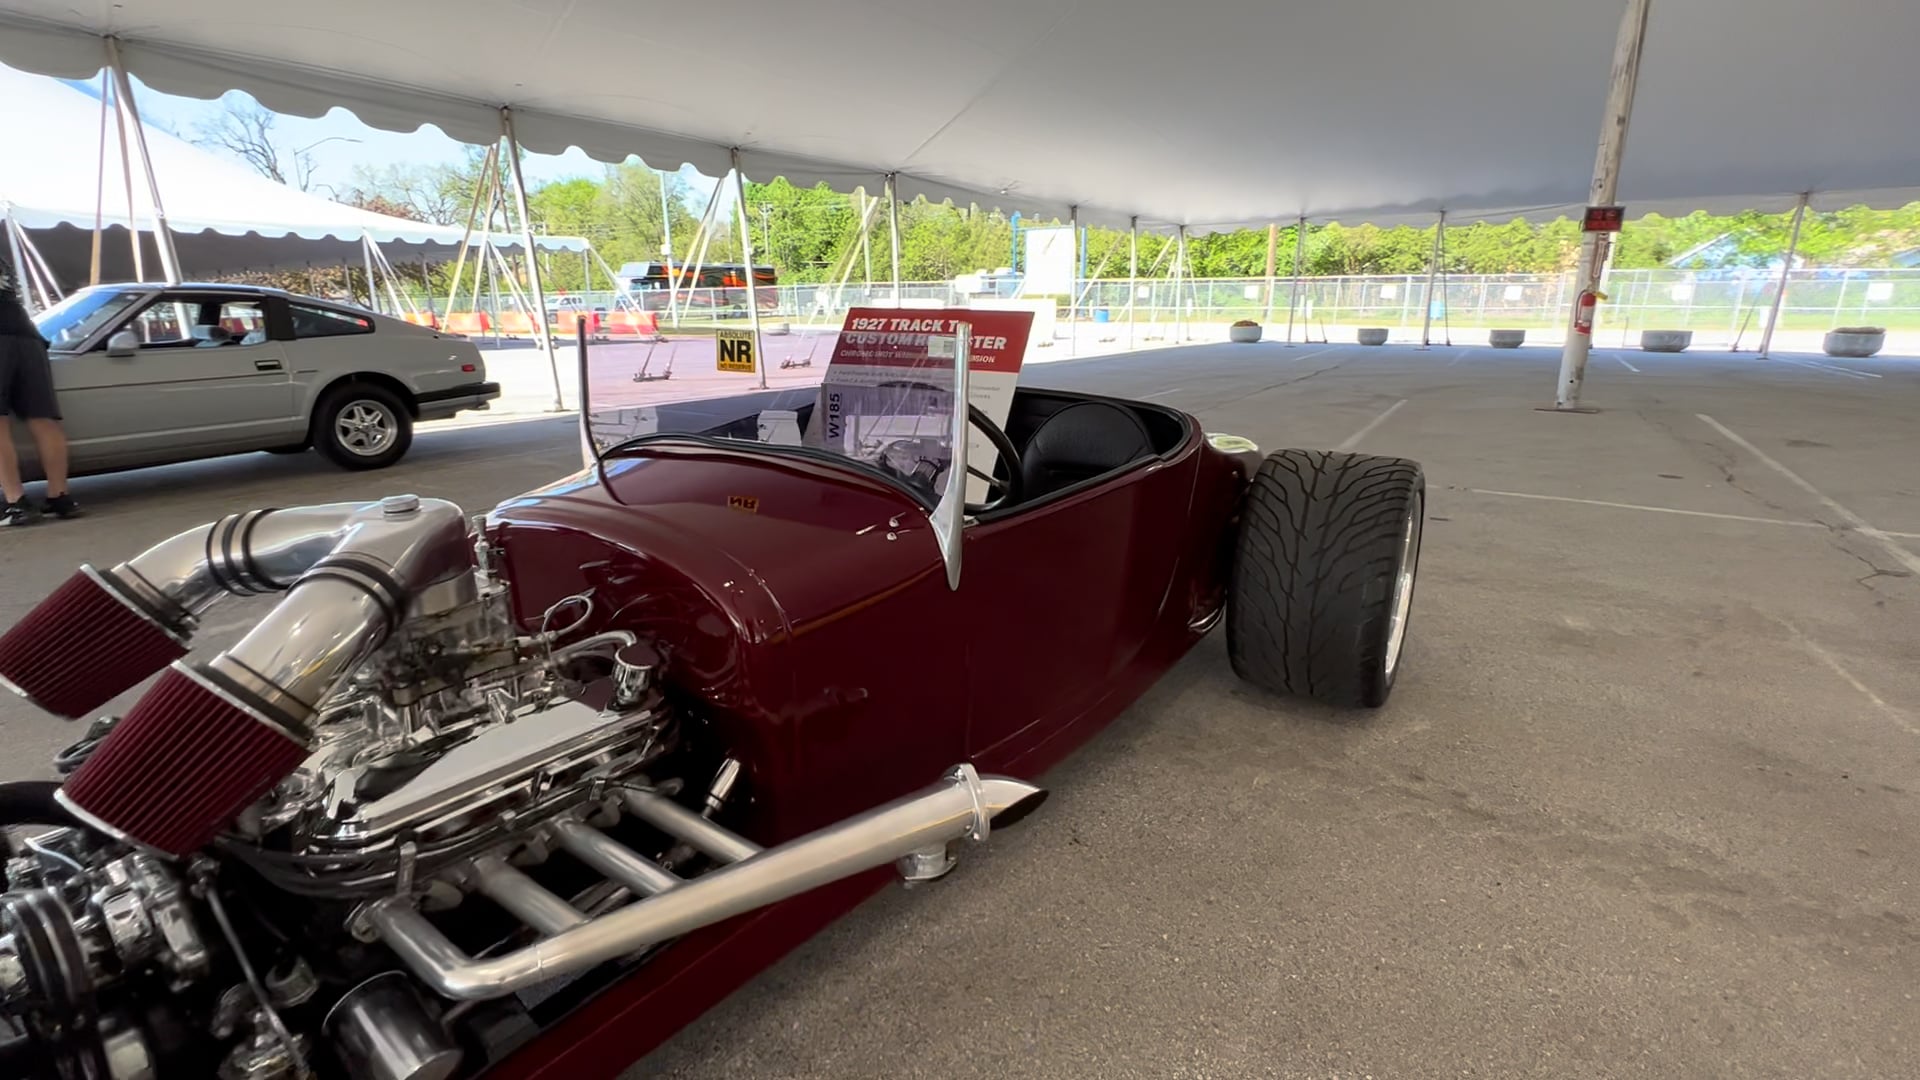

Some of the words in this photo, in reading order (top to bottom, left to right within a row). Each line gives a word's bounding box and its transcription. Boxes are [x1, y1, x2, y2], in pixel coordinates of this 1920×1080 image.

[852, 317, 888, 331] 1927
[890, 318, 944, 332] TRACK
[719, 331, 753, 339] ABSOLUTE
[845, 331, 915, 346] CUSTOM
[720, 339, 752, 363] NR
[829, 393, 840, 438] W185
